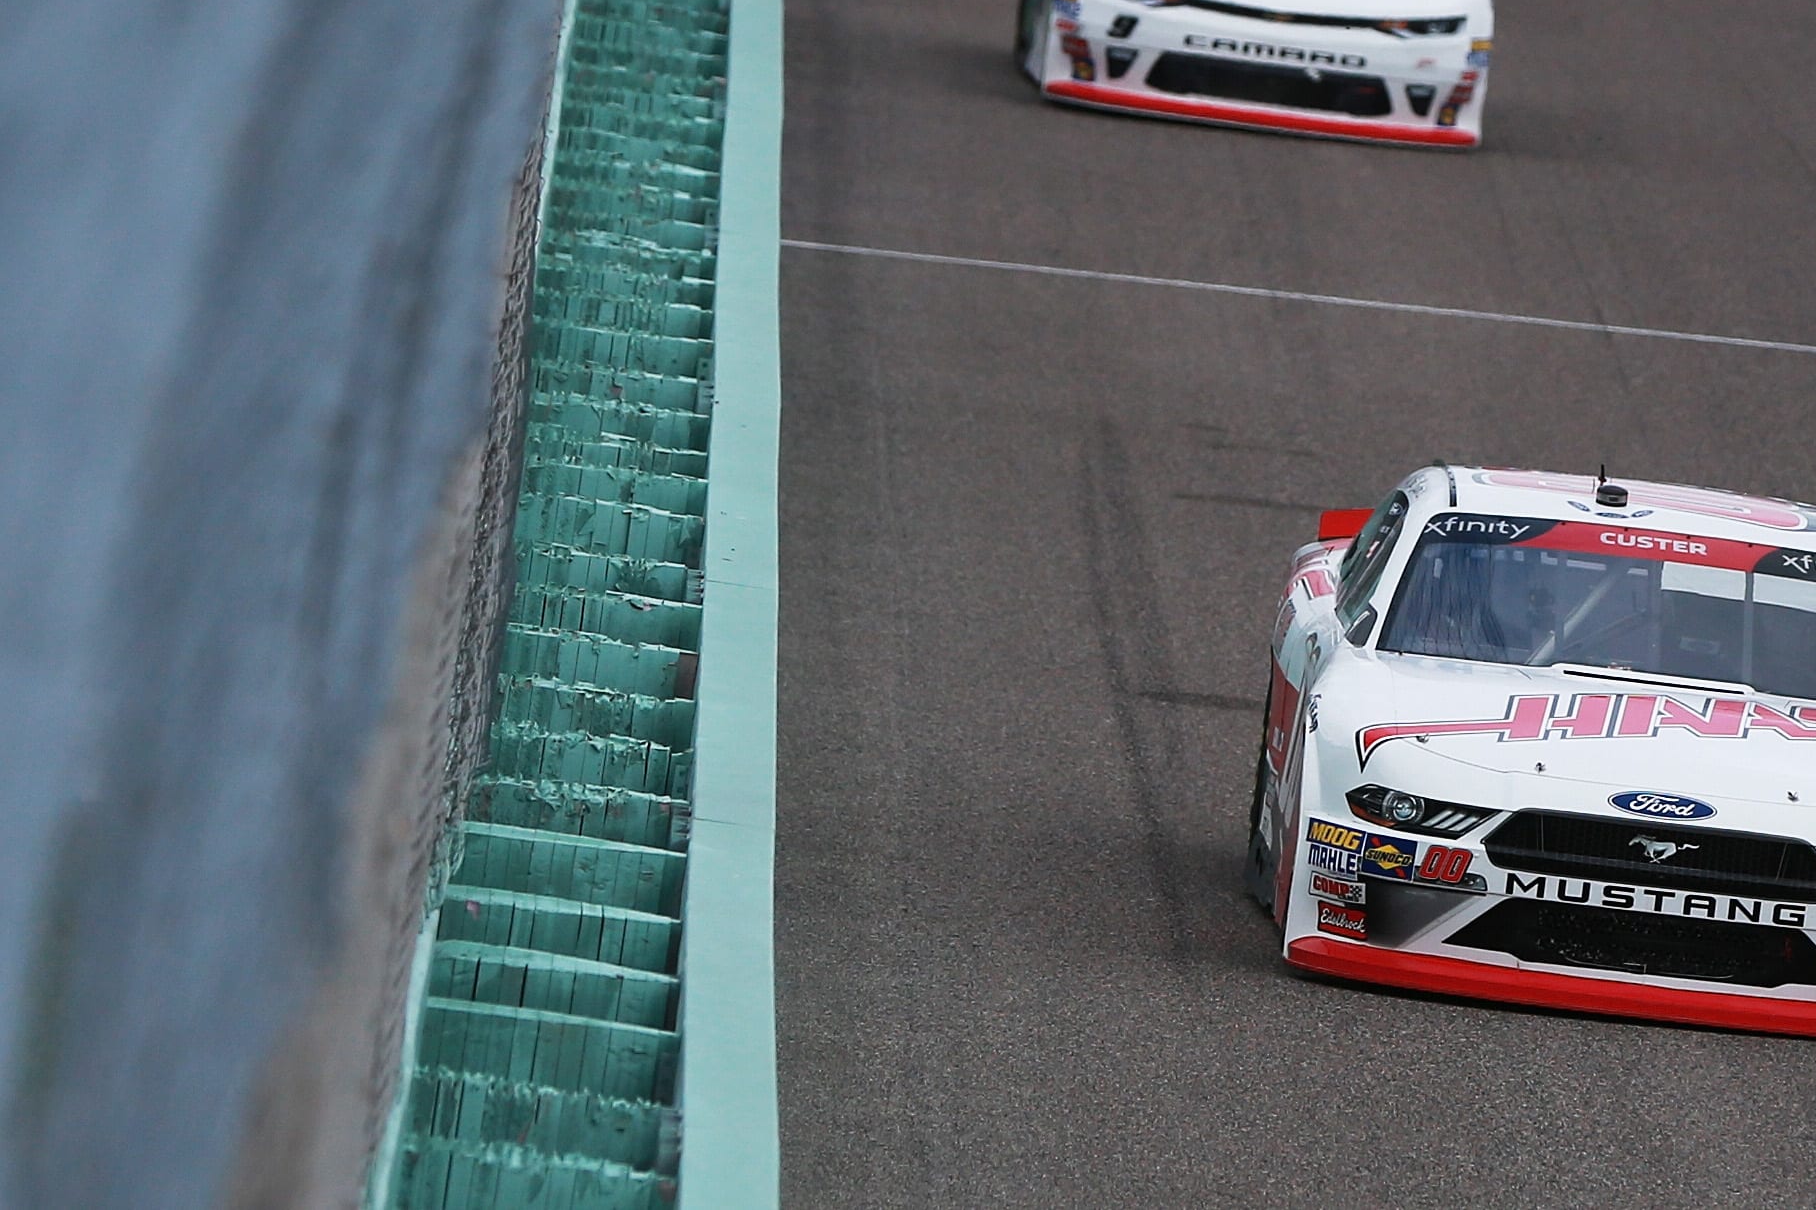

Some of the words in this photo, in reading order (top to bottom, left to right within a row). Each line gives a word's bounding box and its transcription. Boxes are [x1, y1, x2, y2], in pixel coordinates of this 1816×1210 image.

[1183, 34, 1369, 69] CAMARO
[1424, 516, 1530, 537] xfinity
[1599, 531, 1708, 557] CUSTER
[1627, 793, 1696, 818] Ford
[1308, 821, 1362, 851] MOOG
[1307, 842, 1359, 874] MAHLE
[1364, 847, 1413, 867] SUNOCO
[1419, 845, 1475, 884] 00
[1504, 872, 1808, 928] MUSTANG
[1320, 906, 1368, 934] Edelbrock
